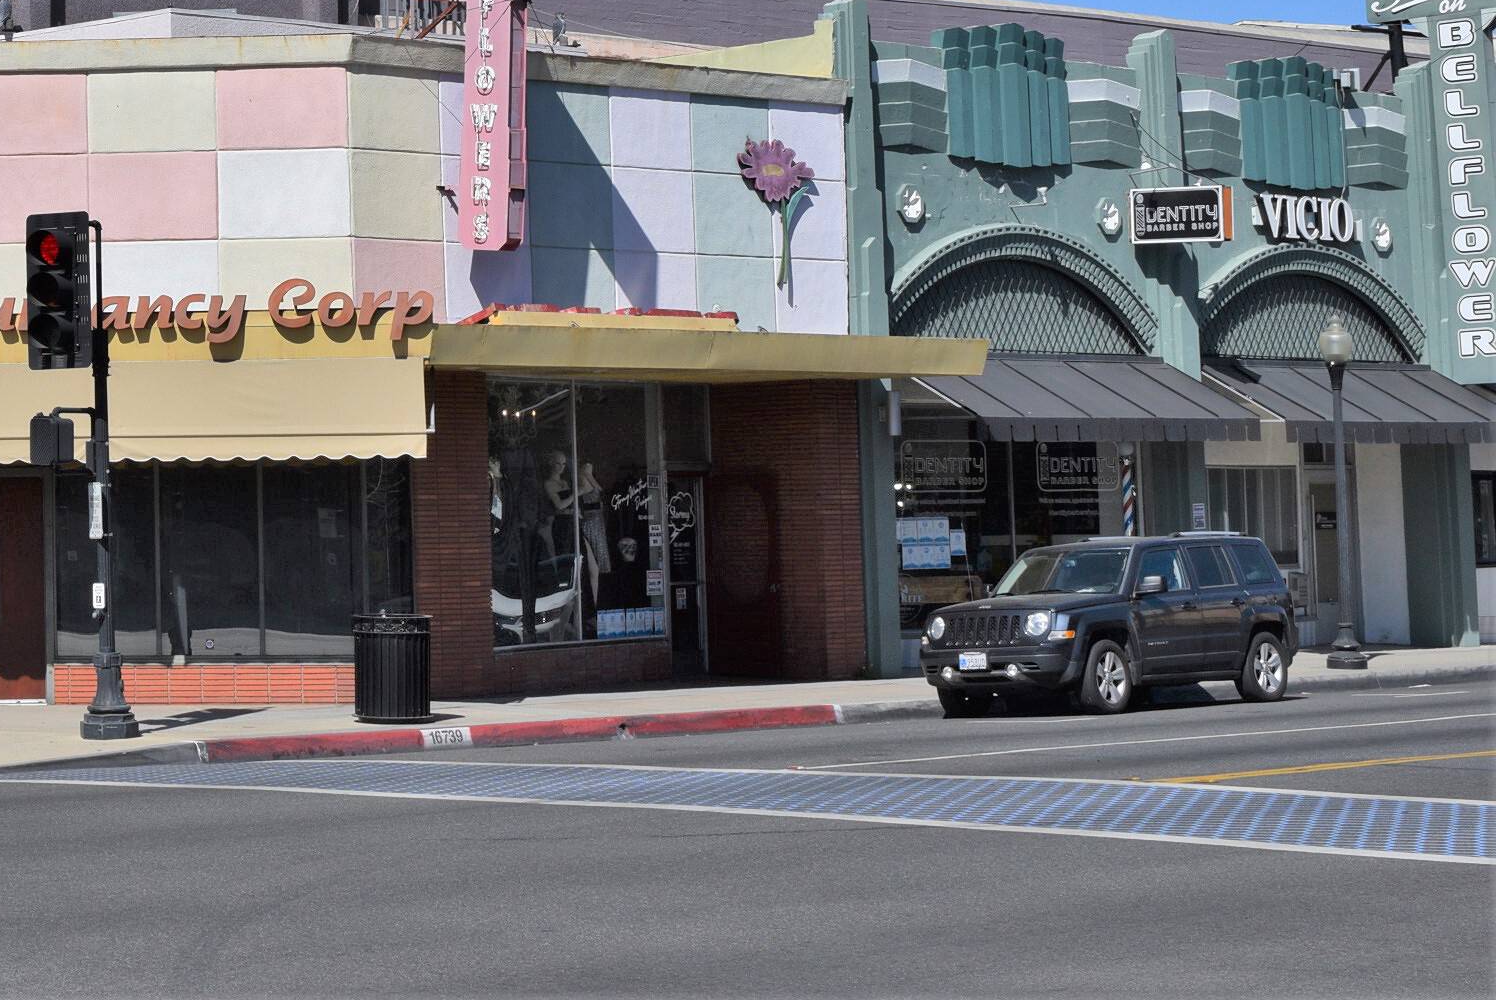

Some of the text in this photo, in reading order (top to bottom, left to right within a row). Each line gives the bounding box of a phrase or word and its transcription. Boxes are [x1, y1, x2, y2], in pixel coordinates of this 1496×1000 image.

[1438, 20, 1496, 359] BELLFLOWER
[1146, 221, 1218, 233] BARBER SHOP
[1259, 193, 1354, 242] VICIO
[268, 278, 434, 341] Corp
[429, 729, 464, 745] 16739
